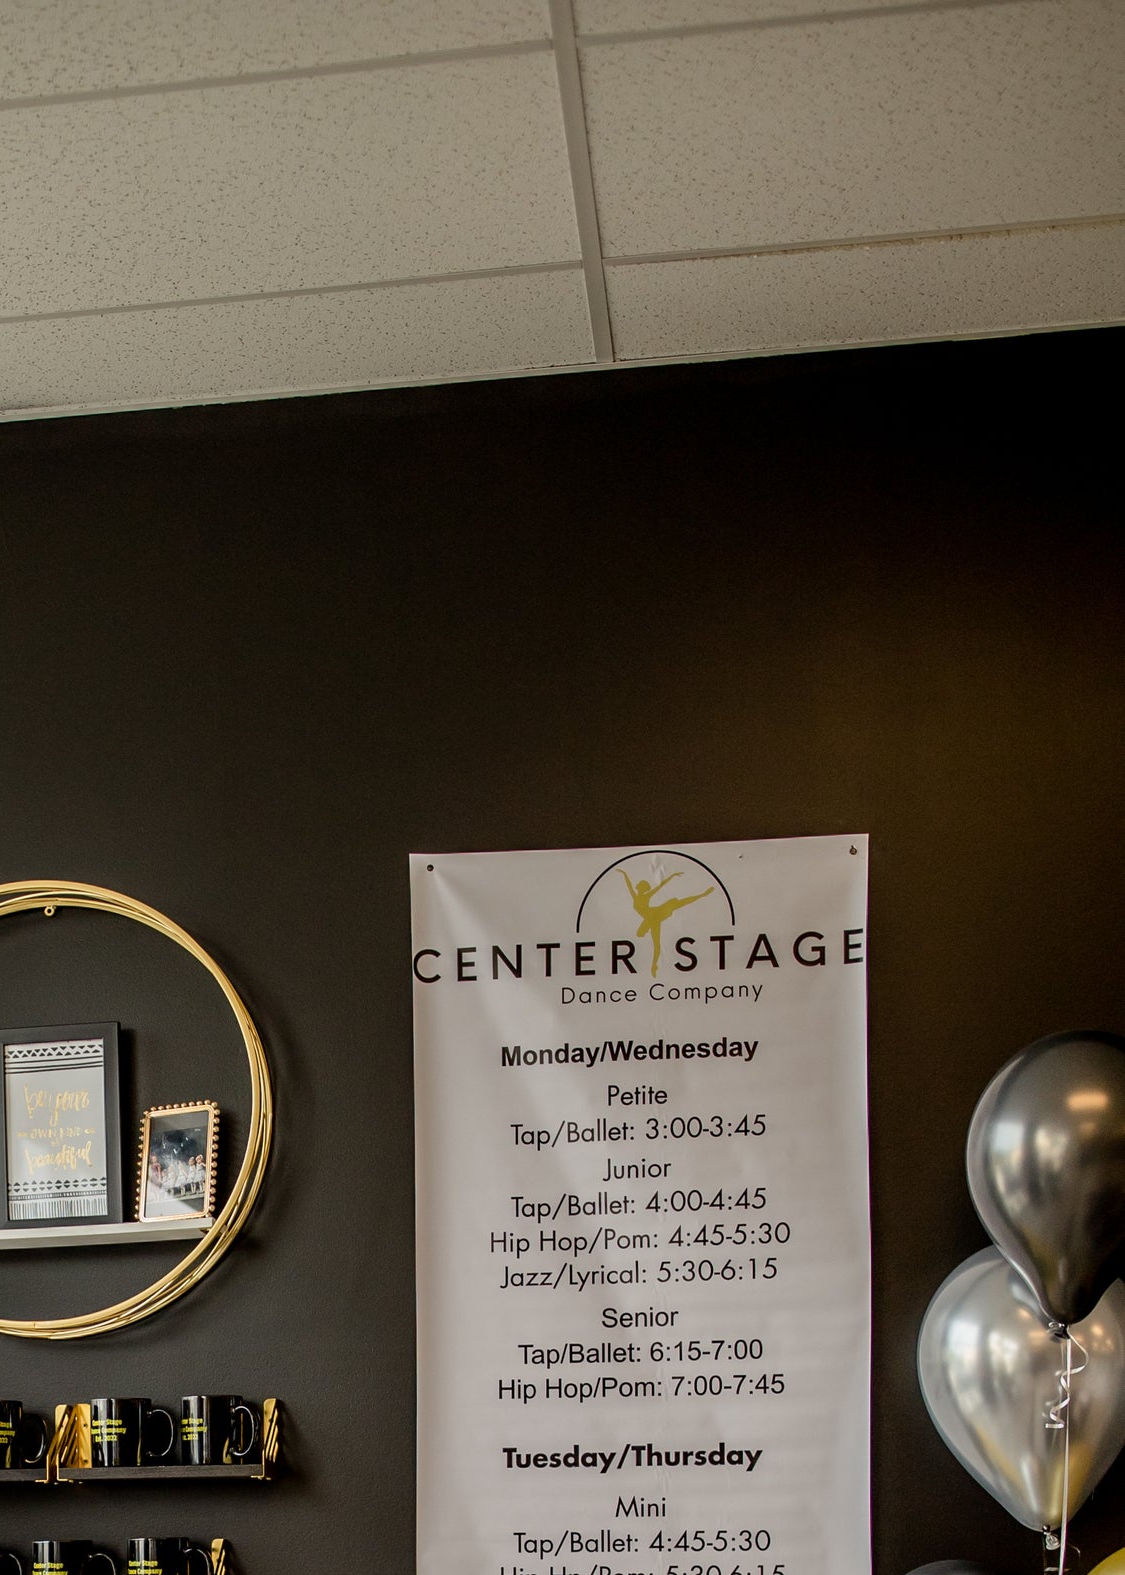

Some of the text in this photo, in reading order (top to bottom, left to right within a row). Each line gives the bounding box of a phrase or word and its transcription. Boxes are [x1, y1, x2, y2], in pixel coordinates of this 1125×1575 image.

[413, 929, 864, 983] CENTER STAGE
[562, 984, 763, 1004] Dance Company
[502, 1037, 758, 1068] Monday/Wednesday
[608, 1085, 667, 1106] Petite
[510, 1114, 765, 1151] Tap/Ballet: 3:00-3:45
[603, 1158, 671, 1181] Junior
[511, 1188, 766, 1224] Tap/Ballet: 4:00-4:45
[491, 1222, 790, 1259] Hip Hop/Pom: 4:45-5:30
[500, 1258, 777, 1292] Jazz/Lyrical: 5:30-6:15
[602, 1307, 679, 1328] Senior
[518, 1339, 763, 1369] Tap/Ballet: 6:15-7:00
[499, 1374, 784, 1404] Hip Hop/Pom: 7:00-7:45
[503, 1442, 763, 1474] Tuesday/Thursday
[616, 1496, 666, 1517] Mini
[513, 1530, 770, 1560] Tap/Ballet: 4:45-5:30
